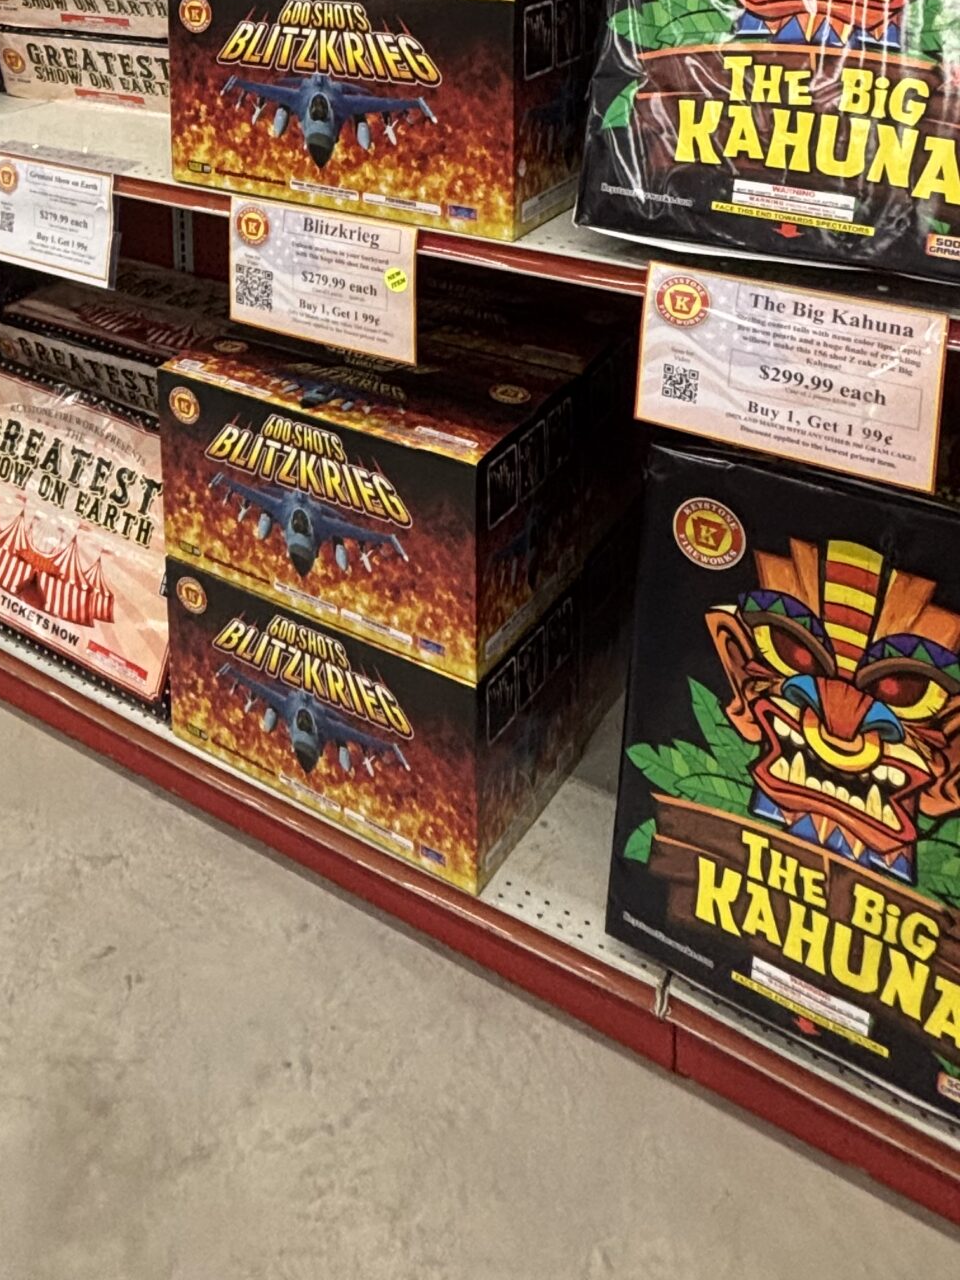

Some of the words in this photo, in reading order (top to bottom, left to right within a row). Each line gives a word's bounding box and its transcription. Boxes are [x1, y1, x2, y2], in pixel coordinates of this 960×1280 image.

[106, 0, 167, 18] EARTH
[26, 42, 169, 82] GREATEST
[217, 21, 441, 86] BLITZKRIEG
[34, 66, 83, 87] SHOW
[90, 71, 114, 90] ON
[122, 77, 169, 97] EART
[723, 56, 813, 106] THE
[674, 100, 960, 205] KAHUNA
[80, 180, 98, 191] Earth
[39, 209, 68, 225] $279.99
[70, 216, 88, 229] each
[303, 217, 379, 249] Blitzkrieg
[715, 204, 735, 213] FACE
[738, 207, 754, 216] THIS
[755, 210, 774, 219] END
[774, 213, 814, 226] TOWARDS
[816, 219, 870, 234] SPECTATORS
[36, 231, 48, 242] Buy
[57, 237, 69, 246] Get
[301, 270, 345, 290] $279.99
[349, 280, 377, 297] each
[386, 268, 402, 284] NEW
[390, 275, 406, 291] ITEM
[299, 298, 317, 313] Buy
[332, 306, 349, 319] Get
[748, 292, 786, 314] The
[792, 300, 825, 325] Big
[831, 308, 914, 339] Kahuna
[811, 328, 829, 338] with
[853, 336, 875, 347] color
[17, 336, 156, 398] GREATEST
[758, 363, 834, 395] $299.99
[839, 381, 887, 407] each
[747, 400, 779, 421] Buy
[786, 409, 801, 427] 1,
[807, 414, 838, 434] Get
[845, 423, 853, 437] 1
[204, 423, 412, 528] BLITZKRIEG
[38, 473, 66, 508] ON
[75, 492, 154, 549] EARTH
[683, 500, 738, 531] KEYSTONE
[678, 533, 738, 566] FIREWORKS
[699, 523, 718, 543] K
[1, 594, 50, 630] TICKETS
[51, 623, 80, 647] NOW
[212, 617, 414, 739] BLITZKRIEG
[741, 830, 827, 909] THE
[695, 856, 960, 1050] KAHUNA
